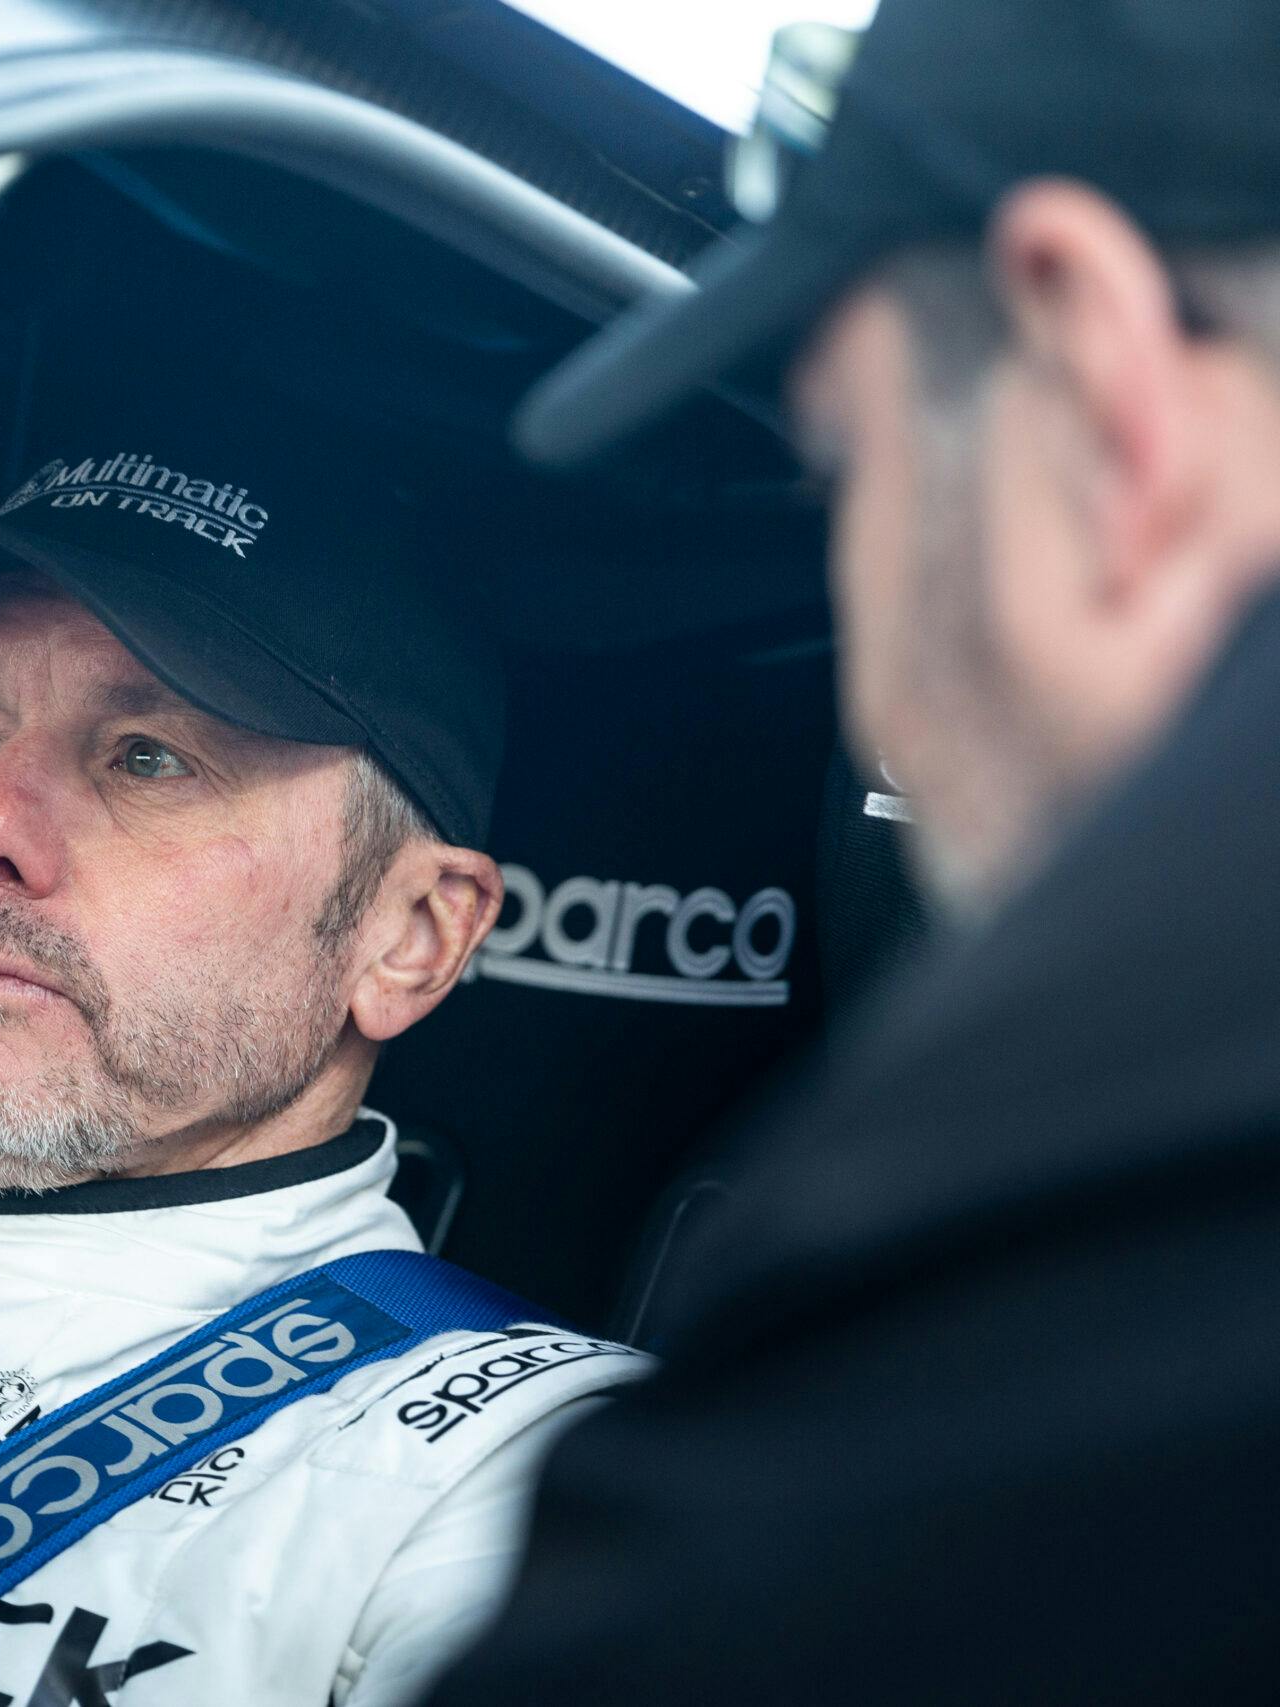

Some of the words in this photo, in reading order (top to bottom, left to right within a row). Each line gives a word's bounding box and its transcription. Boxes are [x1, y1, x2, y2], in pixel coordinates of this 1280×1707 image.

[45, 452, 268, 530] Multimatic
[51, 491, 110, 508] ON
[118, 496, 254, 559] TRACK
[466, 863, 796, 981] parco
